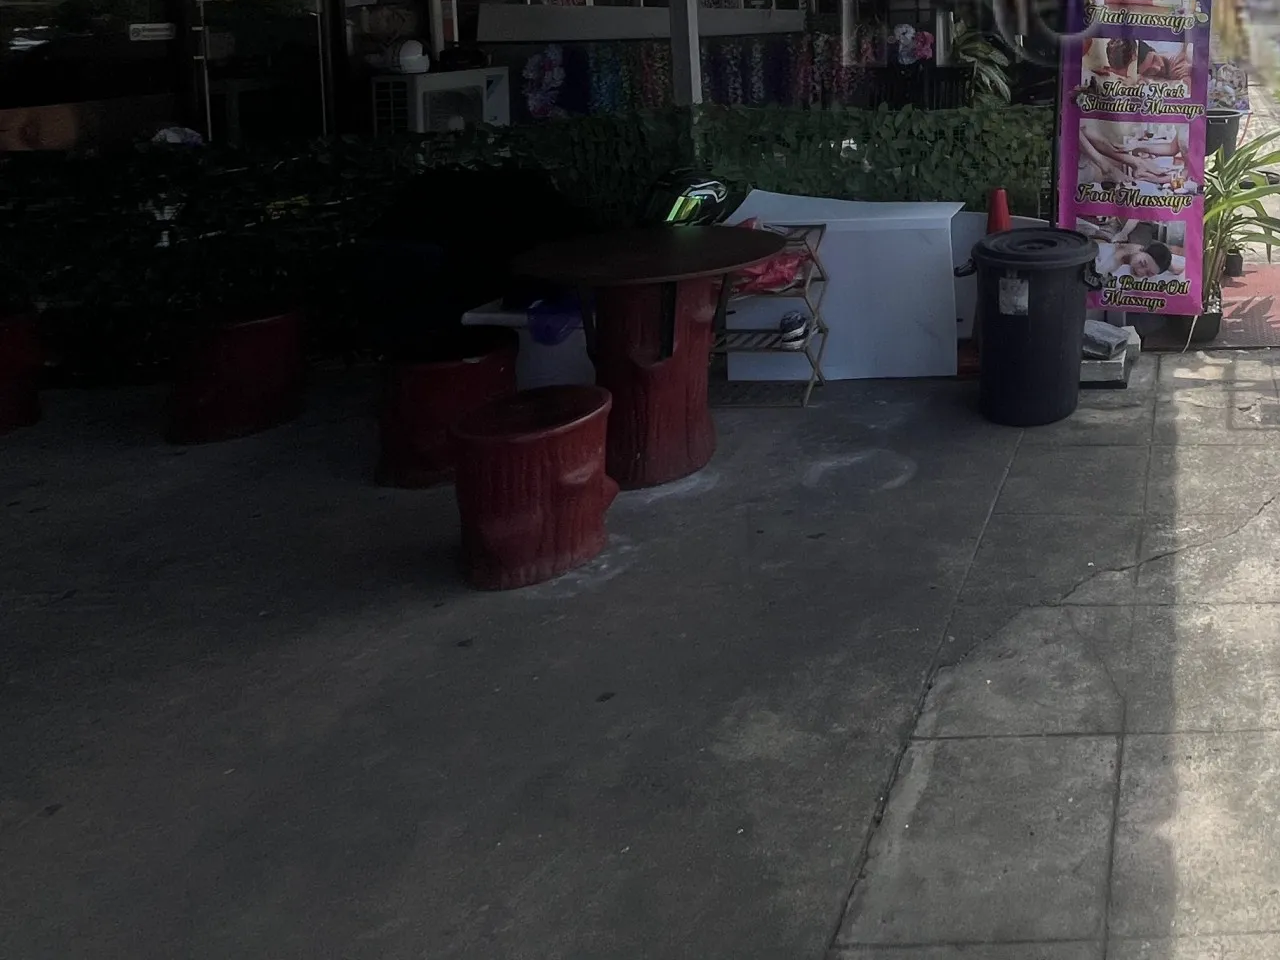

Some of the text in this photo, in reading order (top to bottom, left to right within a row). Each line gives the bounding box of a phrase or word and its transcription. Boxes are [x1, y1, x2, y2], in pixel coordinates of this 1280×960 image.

[1085, 6, 1195, 34] Thai massage
[1147, 82, 1186, 99] Neck
[1081, 95, 1205, 119] Shoulder Massage
[1075, 184, 1192, 214] Foot Massage
[1101, 290, 1166, 311] Massage
